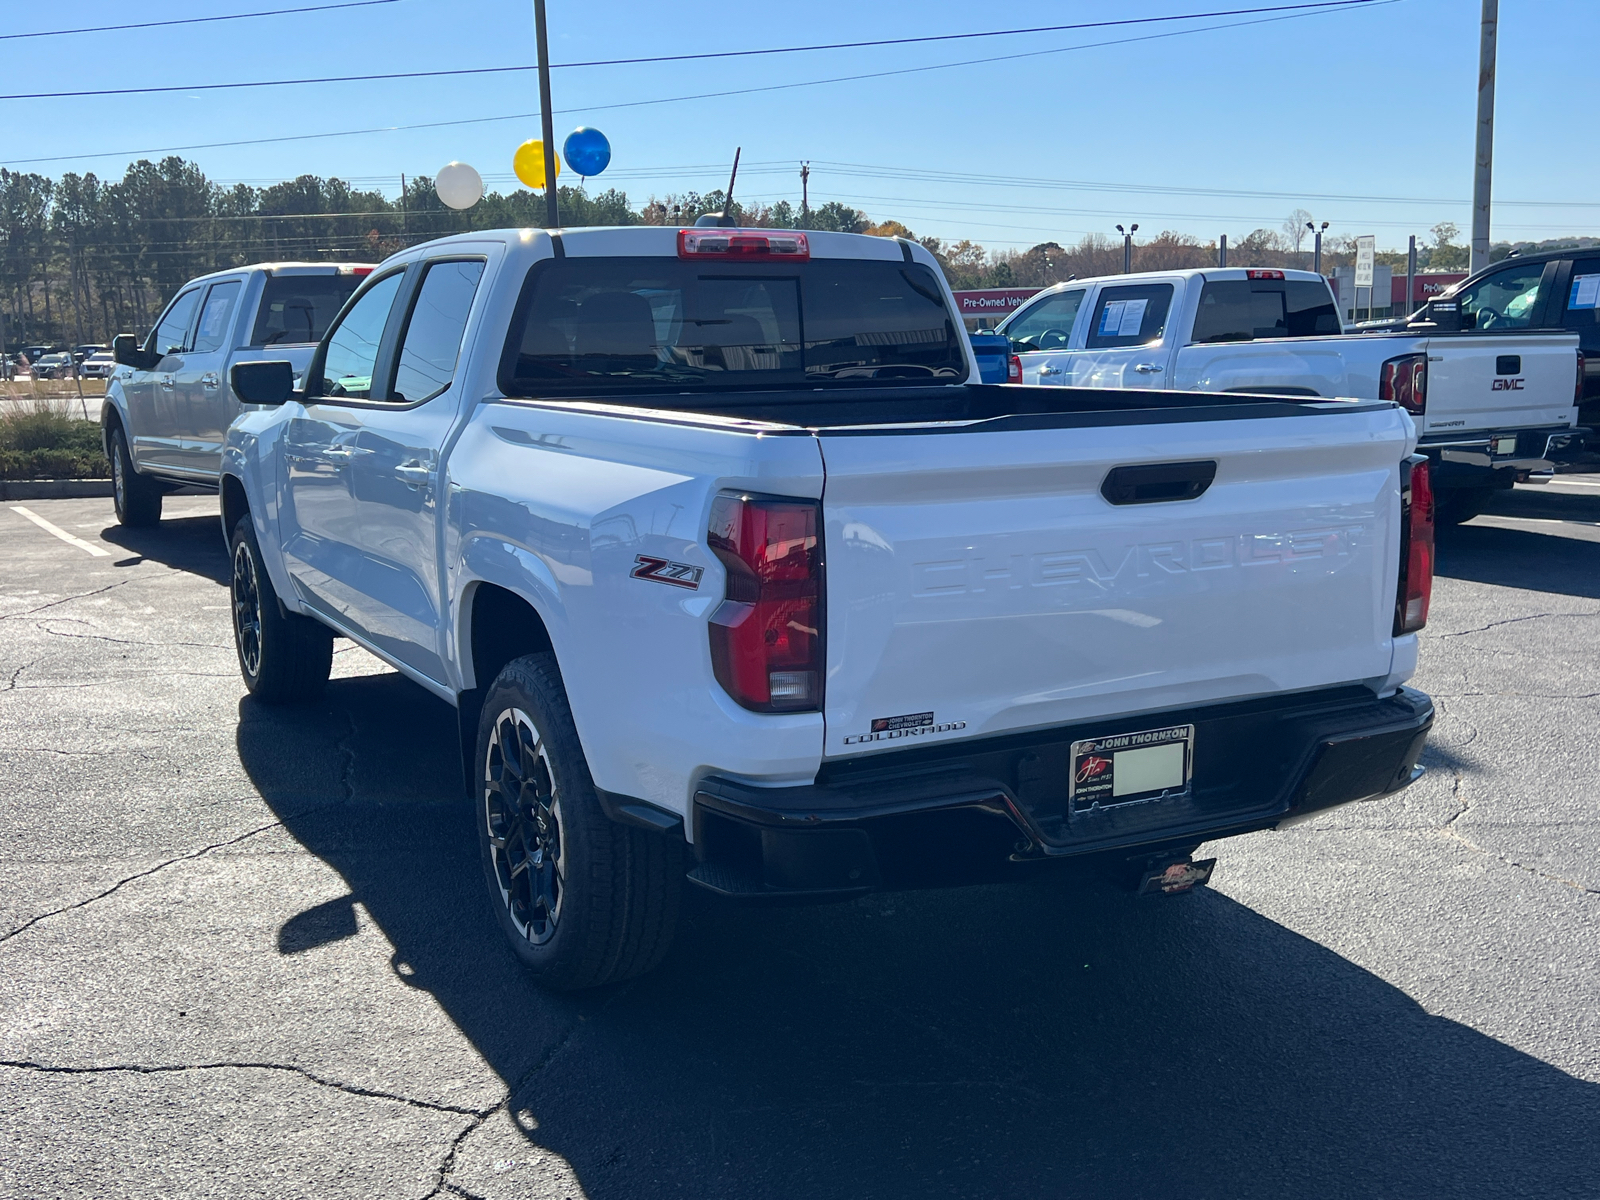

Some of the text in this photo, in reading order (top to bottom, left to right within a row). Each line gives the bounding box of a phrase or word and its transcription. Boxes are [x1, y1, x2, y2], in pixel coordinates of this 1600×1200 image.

[963, 298, 1005, 307] Pre-Owned
[1491, 378, 1525, 391] GMC
[911, 523, 1365, 597] CHEVROLET
[629, 553, 705, 591] Z71
[888, 721, 921, 729] CHEVROLET
[904, 713, 933, 722] THORNTON
[843, 720, 966, 744] COLORADO
[1099, 728, 1187, 750] JOHN THORNTON
